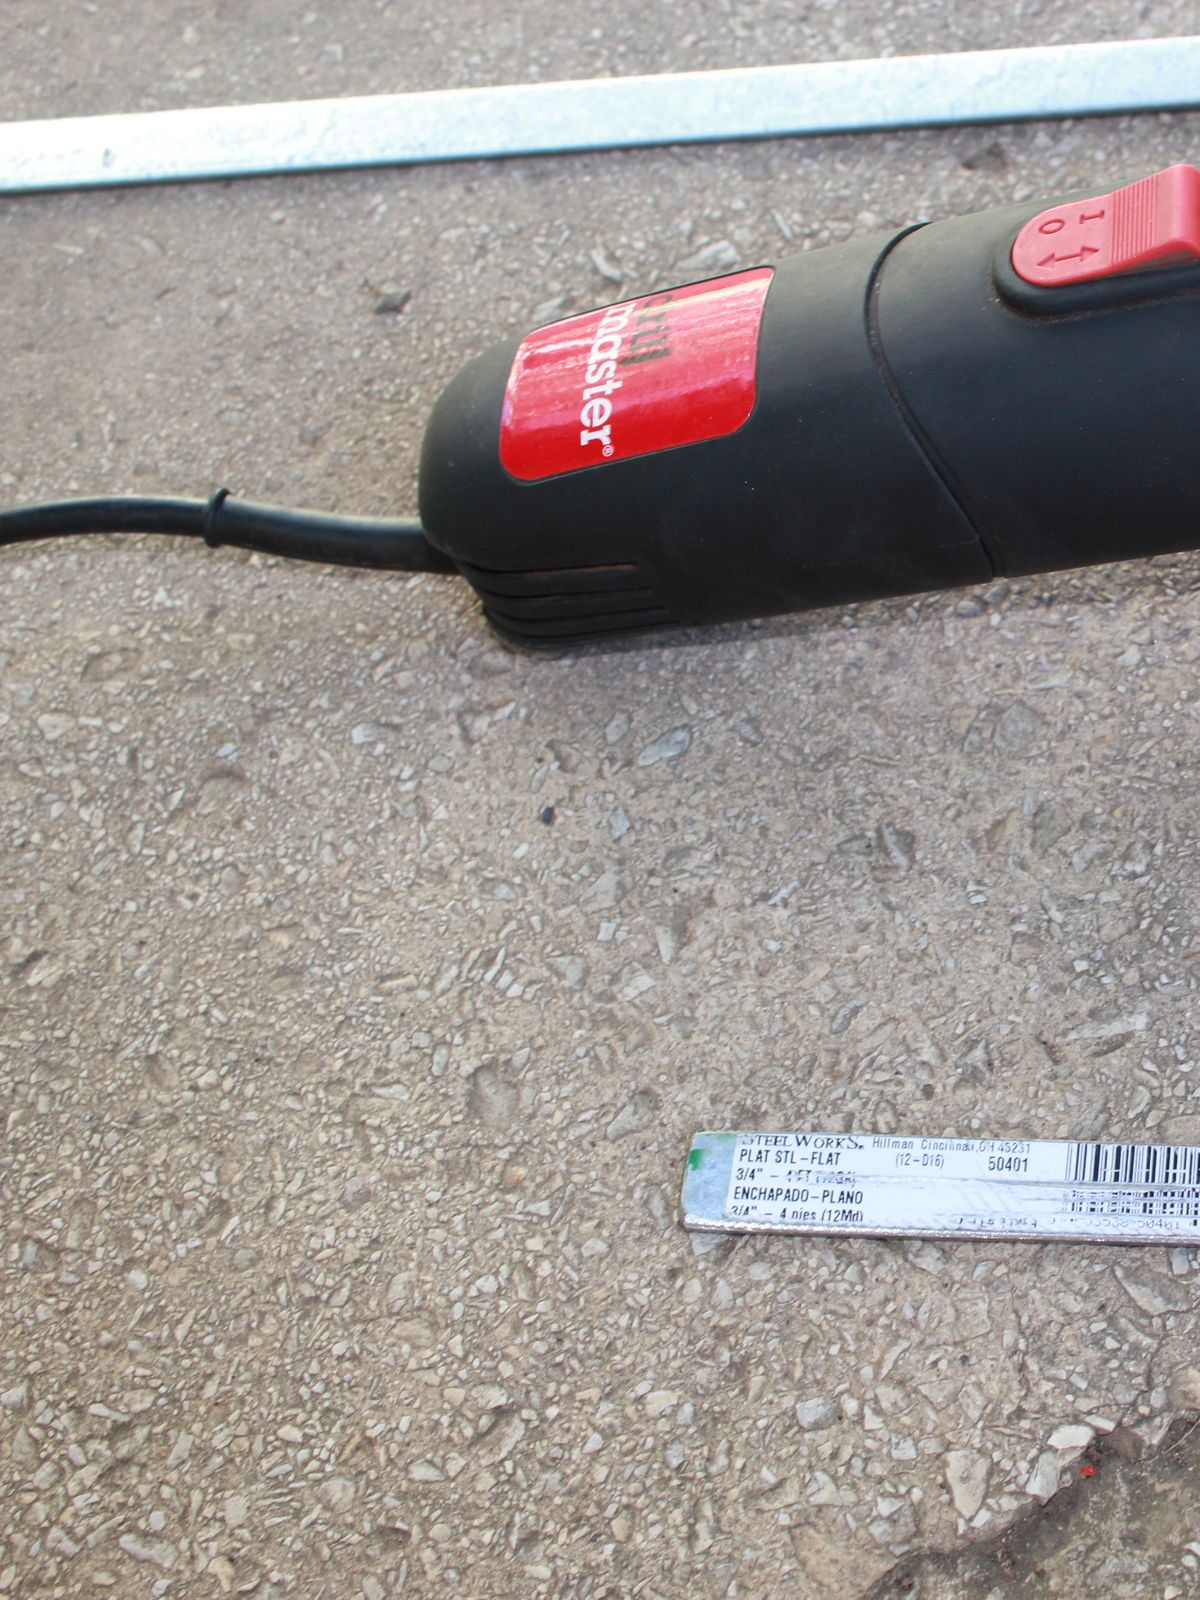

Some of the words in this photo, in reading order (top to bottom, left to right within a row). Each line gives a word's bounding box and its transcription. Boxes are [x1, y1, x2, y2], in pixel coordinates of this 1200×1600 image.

[580, 303, 637, 446] master
[872, 1138, 914, 1149] Hillman
[740, 1149, 770, 1163] PLAT
[988, 1157, 1029, 1172] 50401
[780, 1208, 788, 1220] 4
